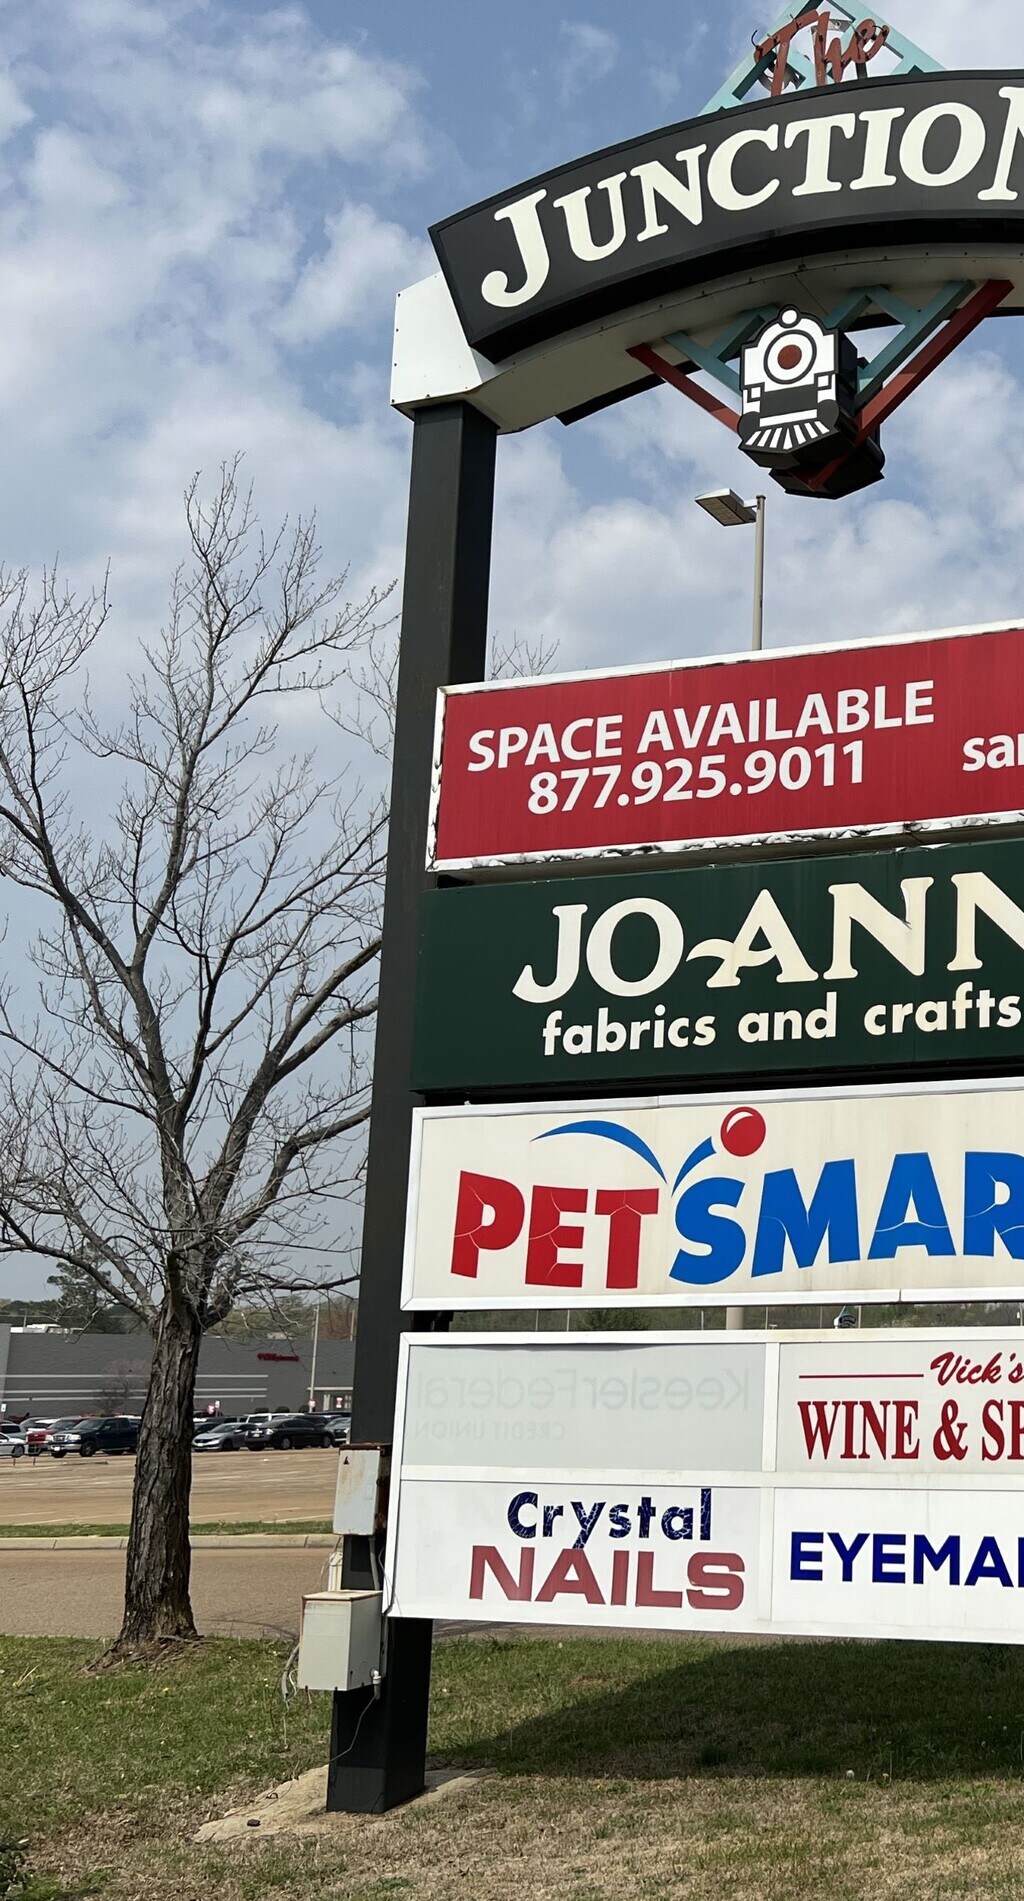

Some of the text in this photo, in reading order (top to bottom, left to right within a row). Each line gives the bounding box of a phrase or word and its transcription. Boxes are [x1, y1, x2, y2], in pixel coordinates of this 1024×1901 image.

[754, 10, 889, 96] The
[467, 680, 935, 772] SPACE AVAILABLE
[527, 740, 864, 815] 877.925.9011
[542, 981, 1022, 1057] fabrics and crafts
[798, 1399, 920, 1460] WINE
[932, 1398, 969, 1462] &
[507, 1487, 713, 1549] Crystal
[468, 1545, 746, 1611] NAILS
